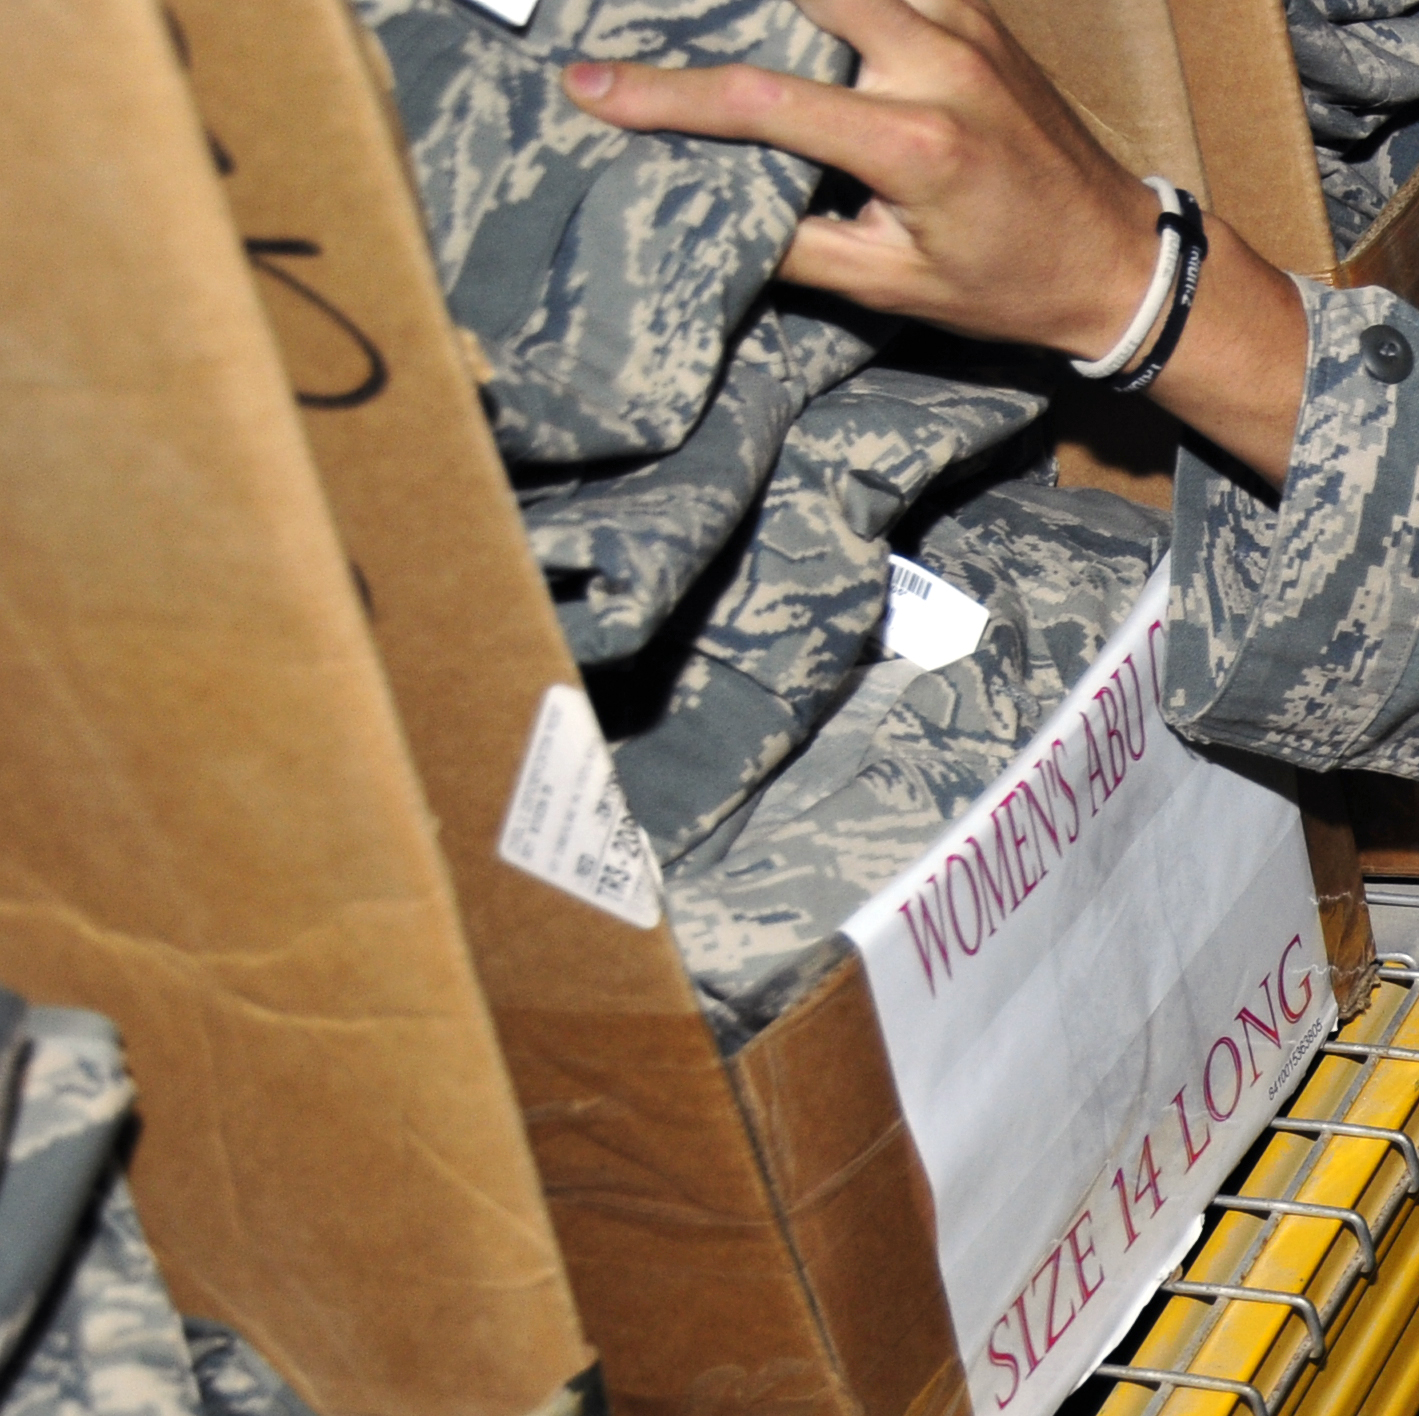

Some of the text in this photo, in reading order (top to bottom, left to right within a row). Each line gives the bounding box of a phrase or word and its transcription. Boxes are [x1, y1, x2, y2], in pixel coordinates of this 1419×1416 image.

[898, 653, 1146, 999] WOMEN'S ABU
[987, 934, 1315, 1410] SIZE 14 LONG
